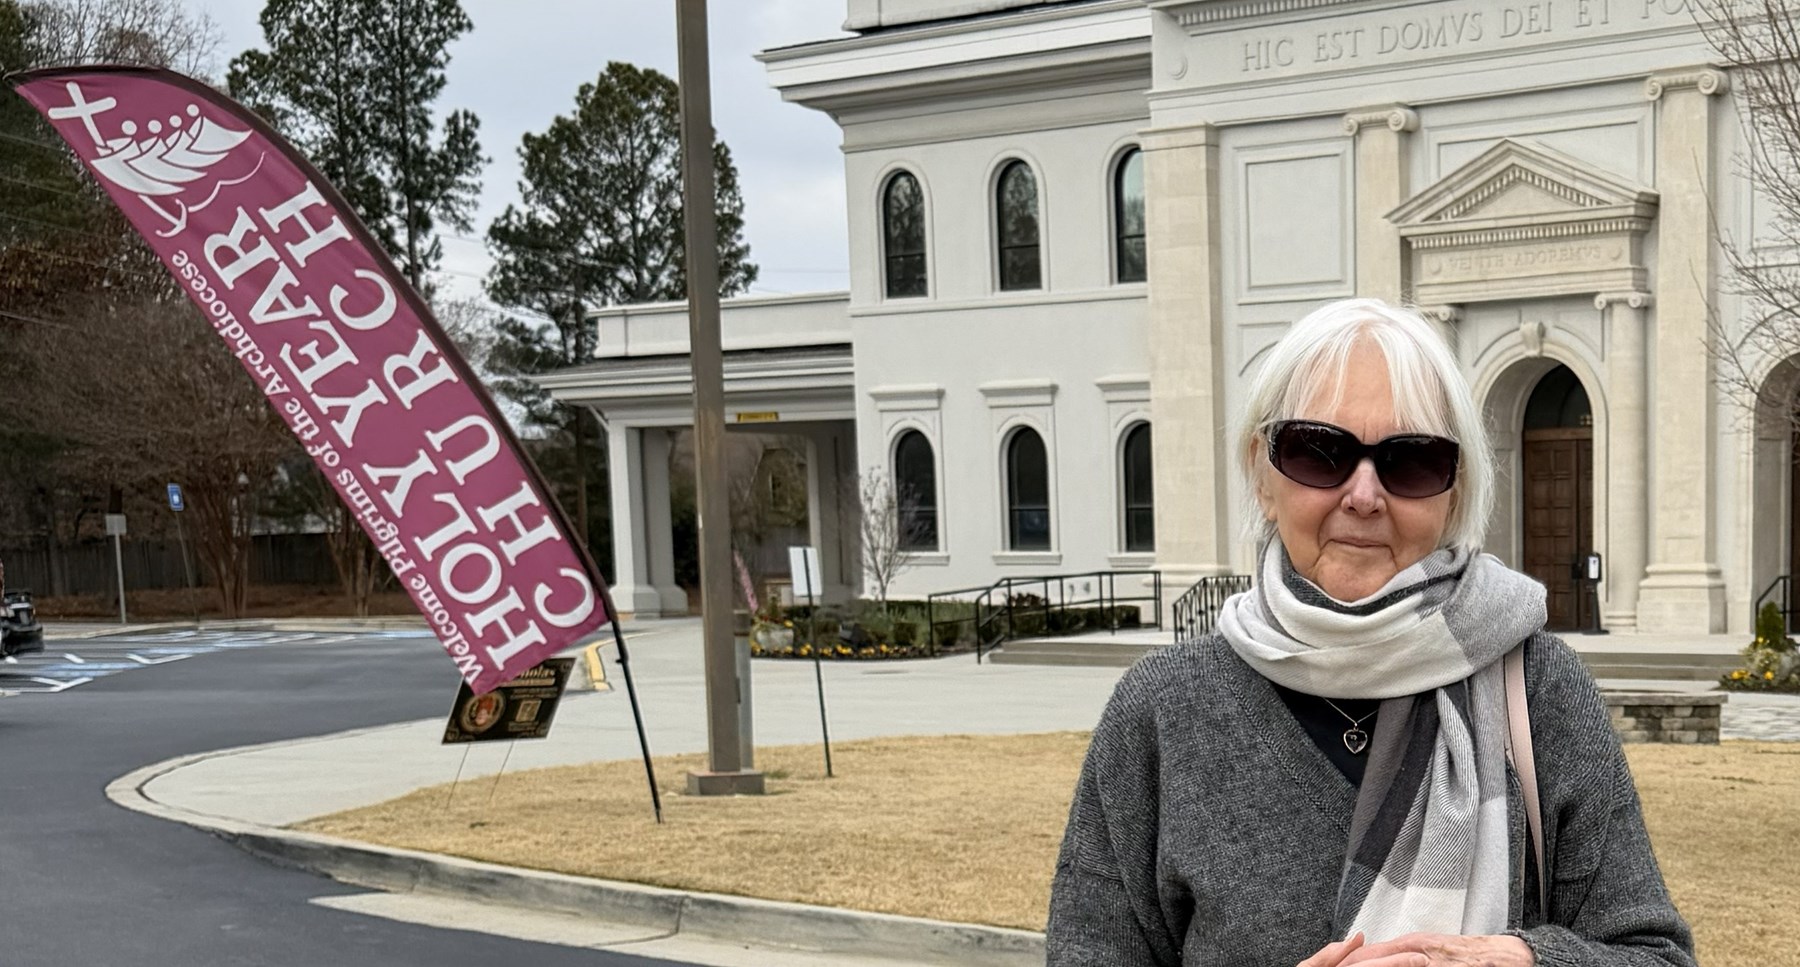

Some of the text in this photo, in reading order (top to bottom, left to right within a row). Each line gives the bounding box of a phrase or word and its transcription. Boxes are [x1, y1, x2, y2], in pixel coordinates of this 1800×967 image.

[1241, 38, 1295, 72] HIC
[1313, 28, 1365, 63] EST
[1376, 12, 1483, 55] DOMVS
[1500, 0, 1552, 38] DEI
[171, 250, 484, 685] Welcome Pilgrims of the Archdiocese
[203, 206, 548, 671] HOLY YEAR
[258, 180, 596, 629] CHURCH
